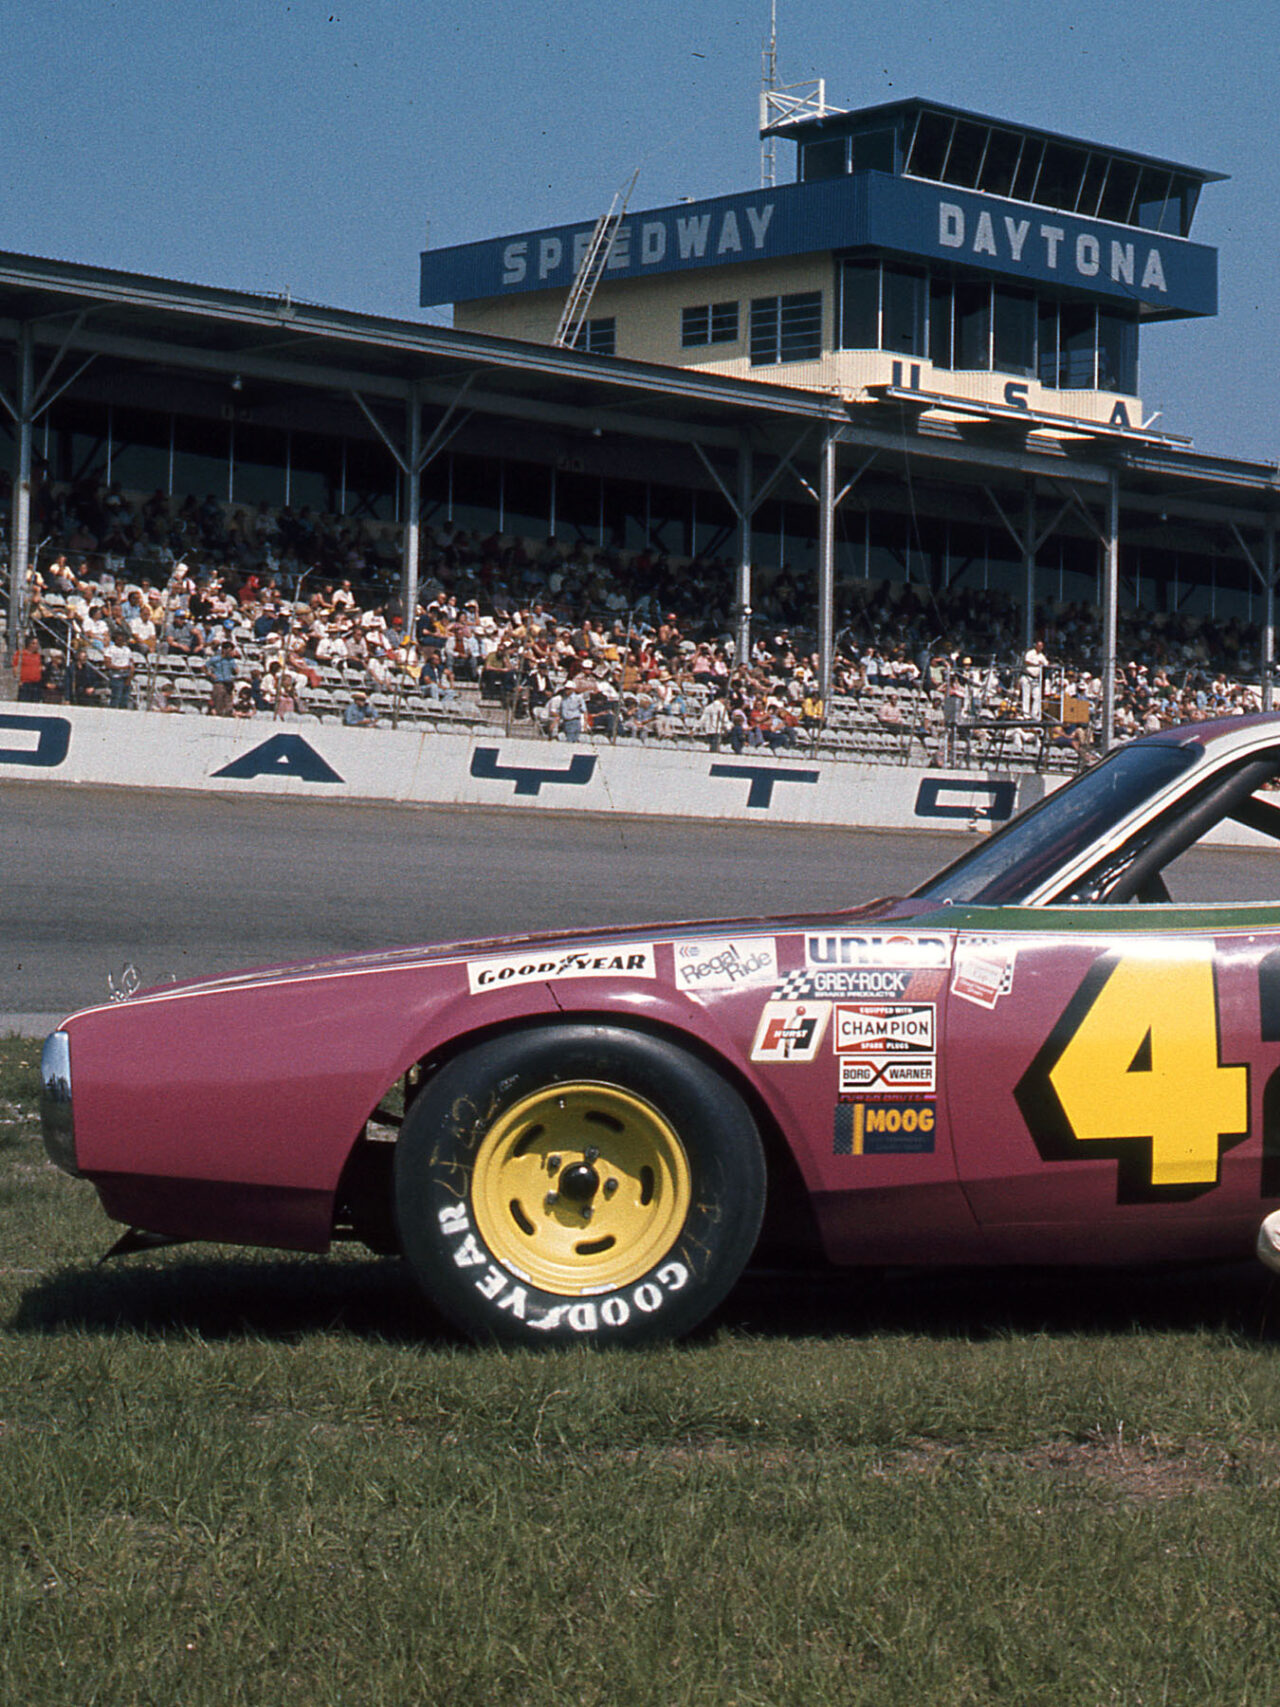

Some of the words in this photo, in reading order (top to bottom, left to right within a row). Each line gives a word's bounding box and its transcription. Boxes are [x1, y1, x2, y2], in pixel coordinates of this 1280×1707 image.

[502, 204, 775, 286] SPEEDWAY
[938, 202, 1168, 293] DAYTONA
[477, 952, 647, 985] GOODYEAR
[680, 943, 740, 984] Regal
[726, 953, 773, 982] Ride
[814, 972, 905, 991] GREY-ROCK
[841, 1021, 930, 1035] CHAMPION
[843, 1068, 870, 1080] BORG
[889, 1068, 932, 1080] WARNER
[866, 1108, 935, 1132] MOOG
[437, 1201, 690, 1332] GOODYEAR
